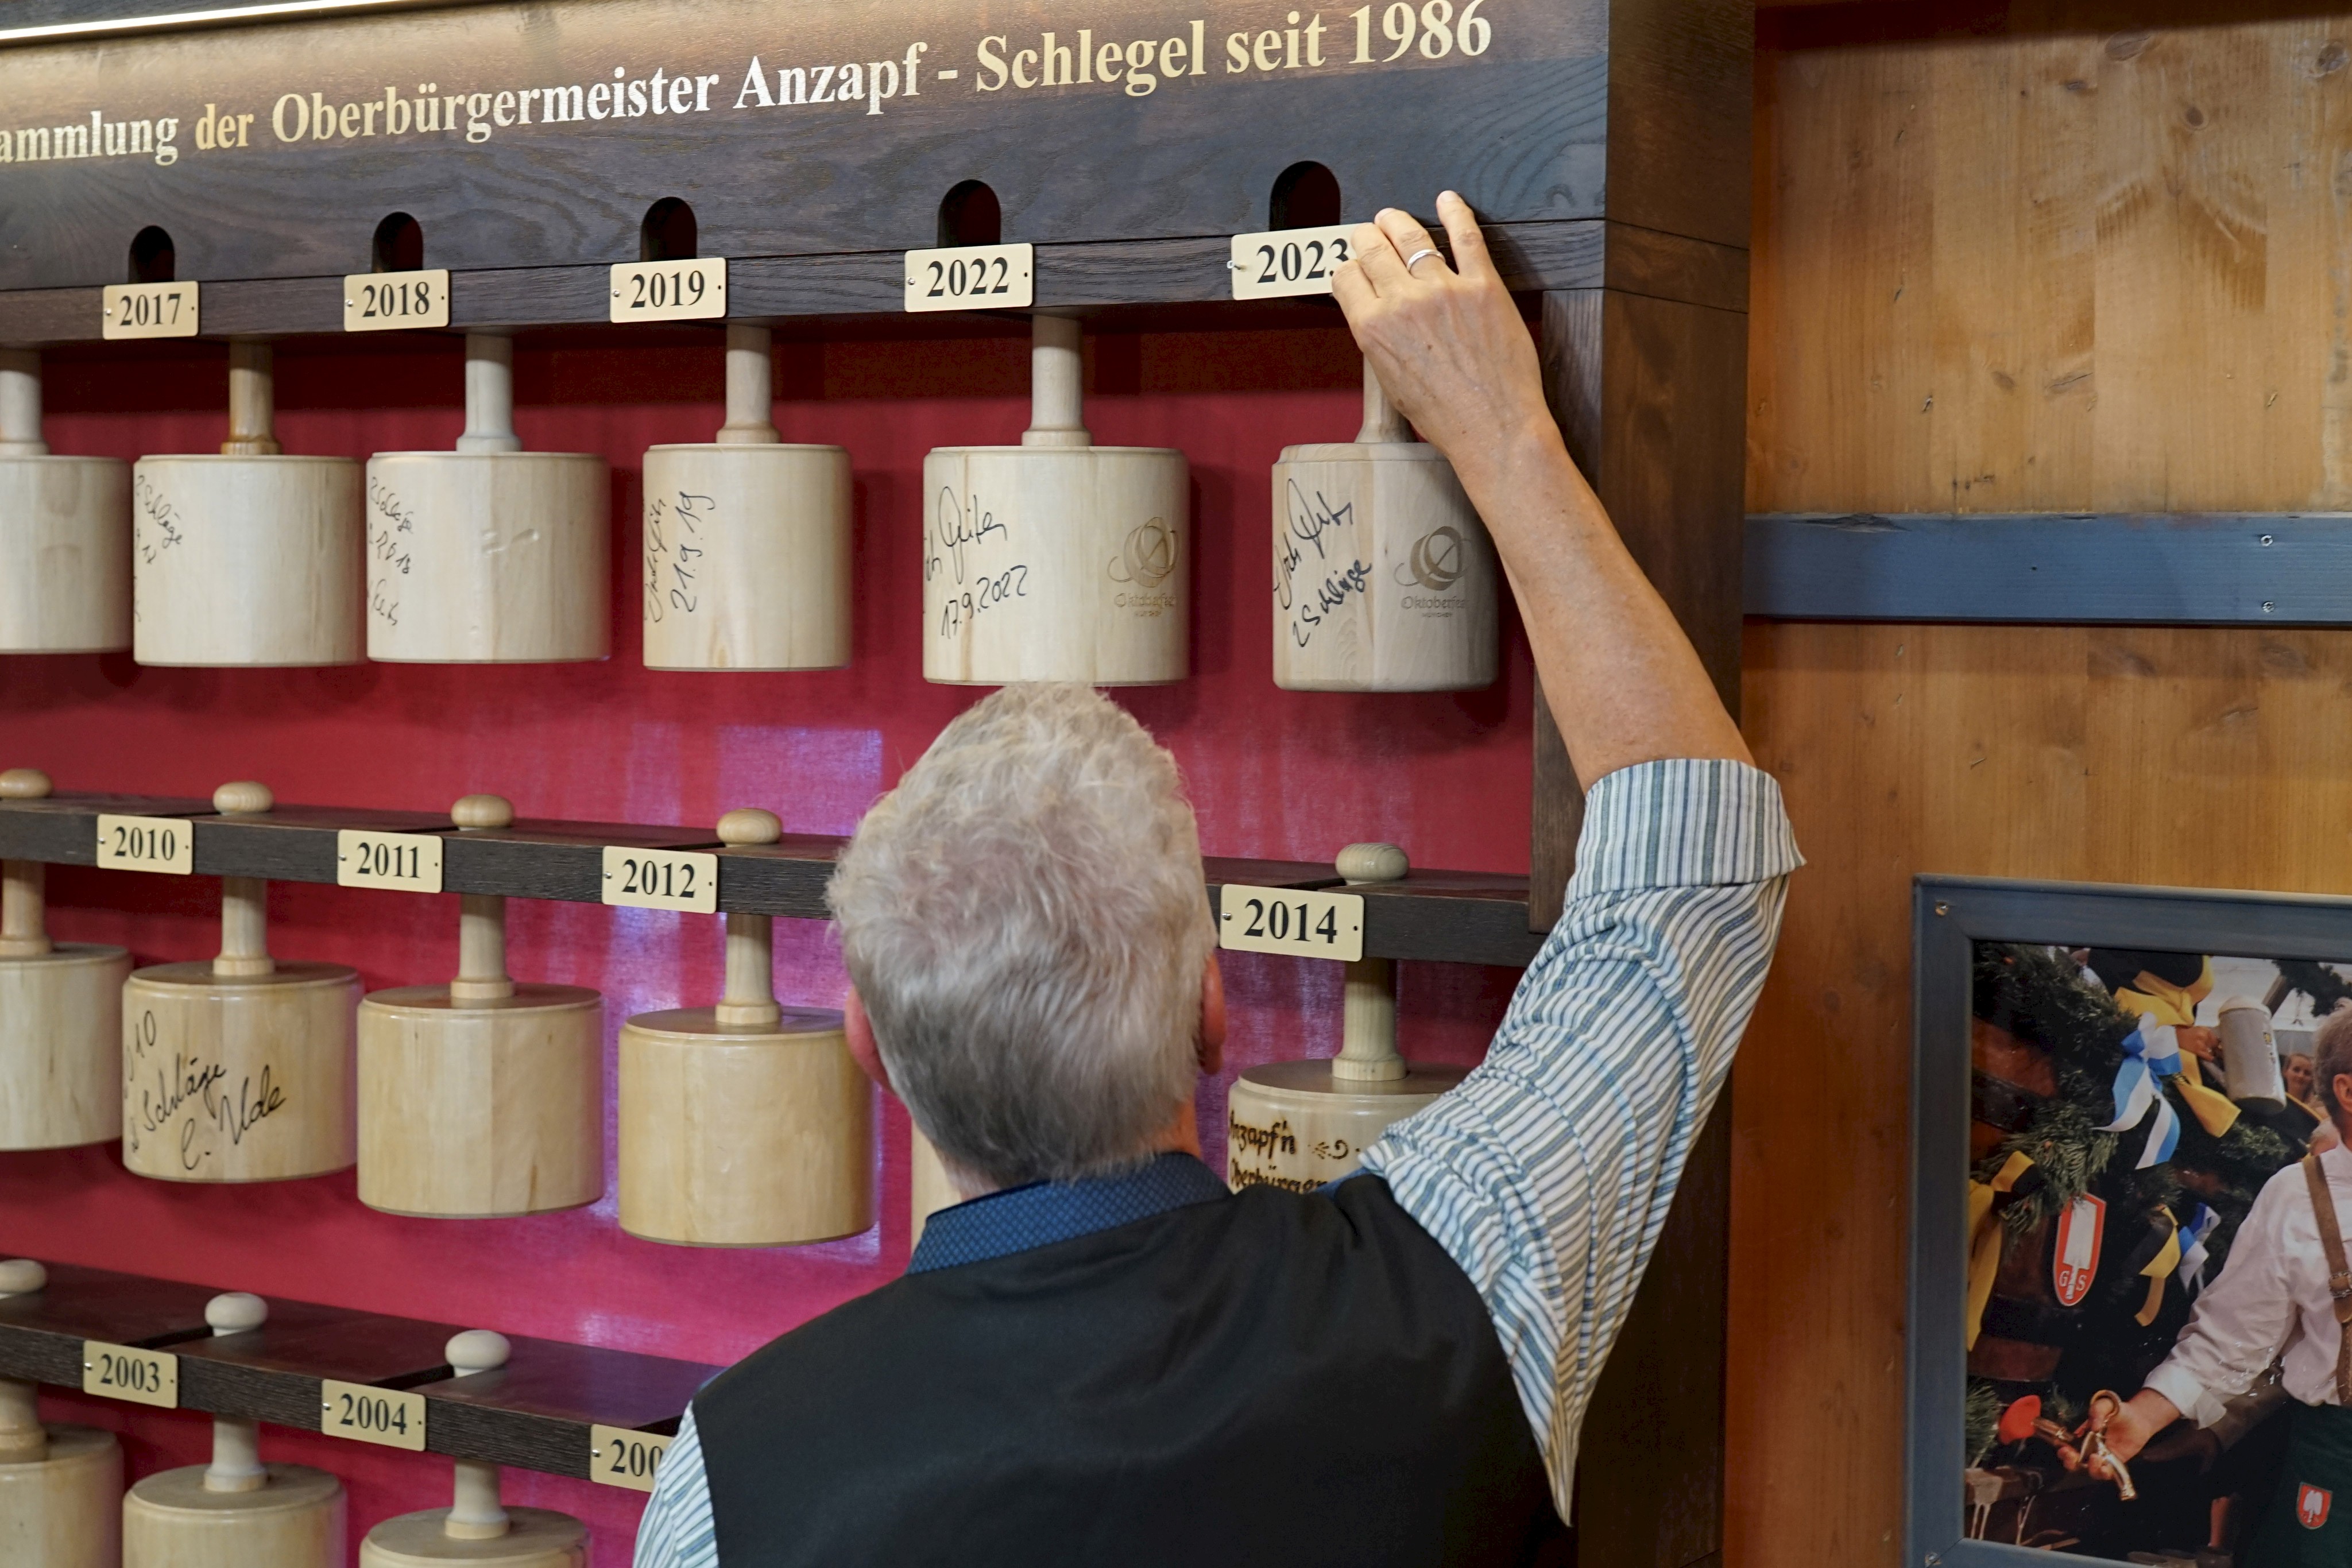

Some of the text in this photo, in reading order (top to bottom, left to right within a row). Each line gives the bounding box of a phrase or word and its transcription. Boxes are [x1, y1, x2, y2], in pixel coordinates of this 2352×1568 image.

[196, 103, 254, 150] der
[272, 66, 720, 144] Oberbürgermeister
[732, 42, 928, 115] Anzapf
[938, 69, 958, 80] -
[976, 20, 1207, 96] Schlegel
[1227, 10, 1328, 73] seit
[1348, 0, 1491, 63] 1986
[629, 270, 705, 308] 2019
[926, 257, 1009, 297] 2022
[119, 293, 181, 327] 2017
[362, 281, 430, 318] 2018
[114, 826, 175, 861] 2010
[357, 842, 420, 879] 2011
[621, 859, 695, 899] 2012
[1244, 899, 1337, 944] 2014
[100, 1353, 160, 1393] 2003
[340, 1393, 407, 1435] 2004
[610, 1439, 663, 1480] 200
